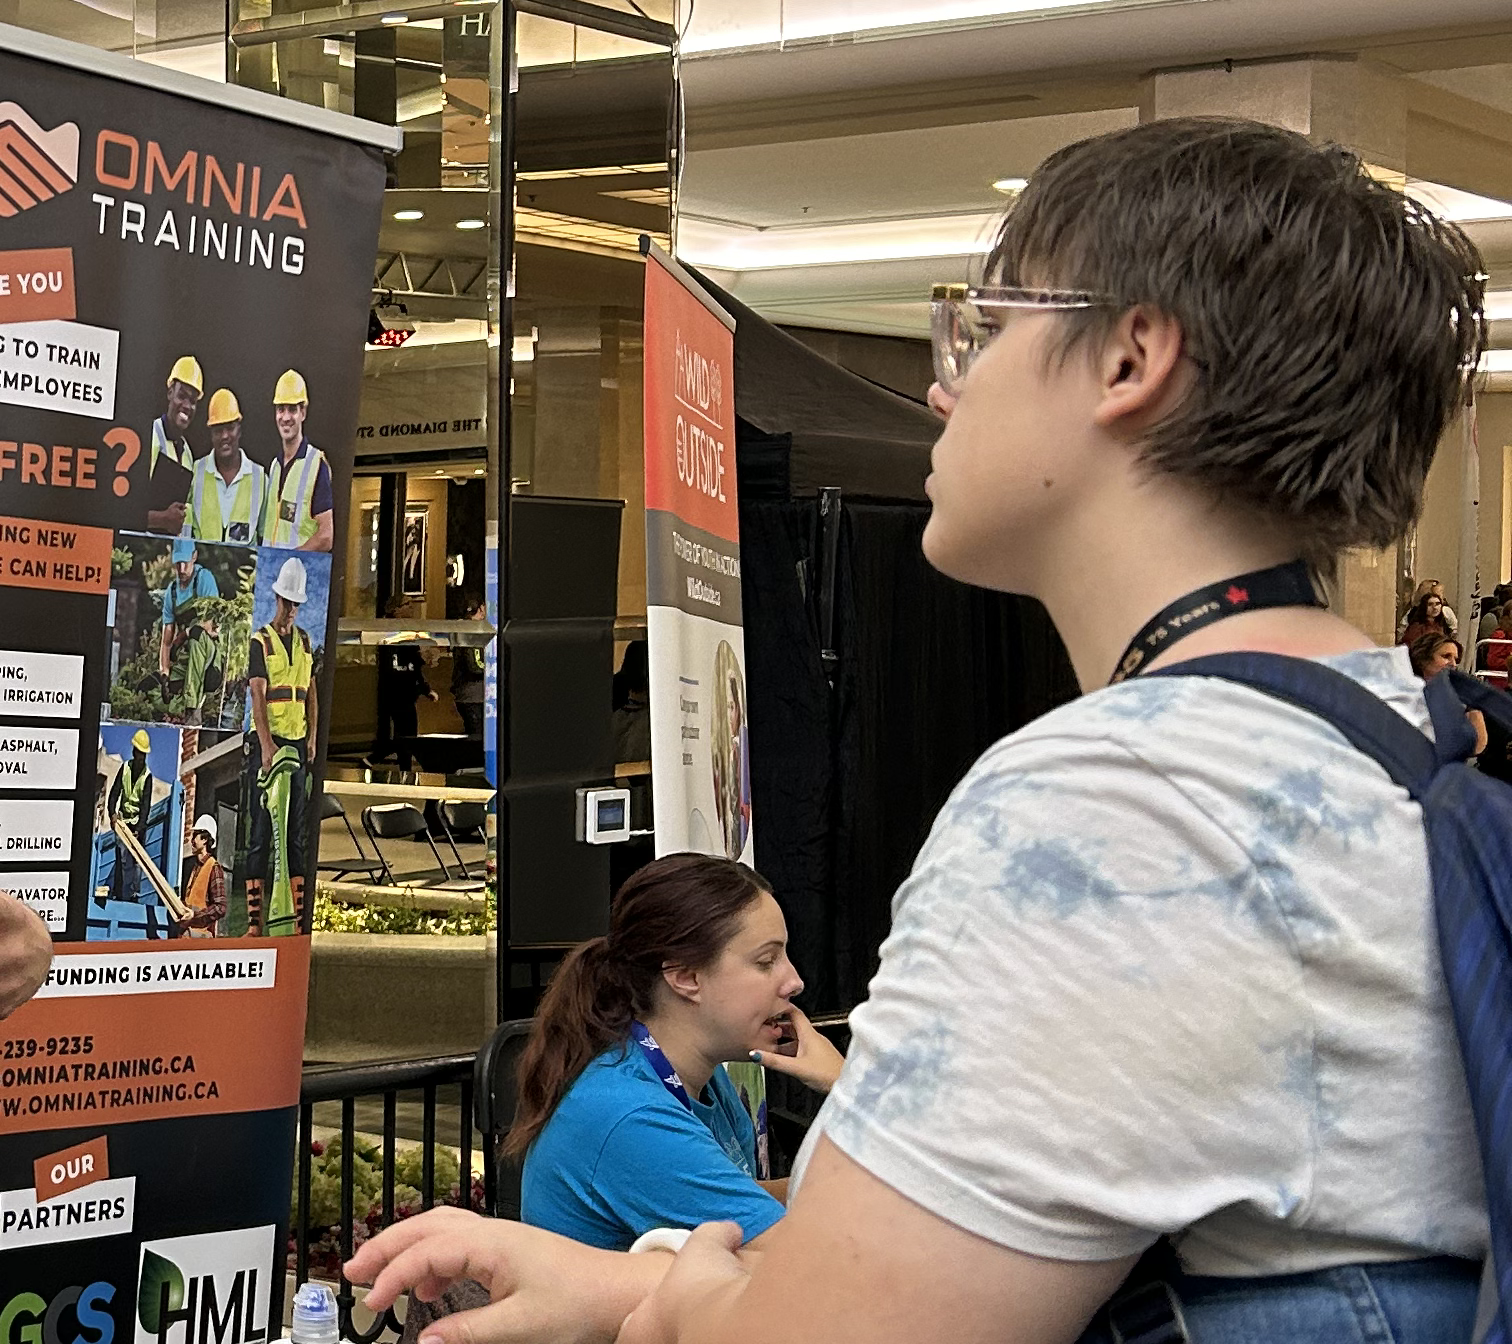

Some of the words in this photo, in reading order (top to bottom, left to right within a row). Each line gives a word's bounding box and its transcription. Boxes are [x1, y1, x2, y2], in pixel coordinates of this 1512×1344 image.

[96, 129, 307, 228] OMNIA
[91, 194, 305, 276] TRAINING
[14, 272, 62, 295] YOU
[12, 337, 39, 359] TO
[45, 343, 101, 370] TRAIN
[675, 414, 726, 504] OUTSIDE
[37, 528, 77, 549] NEW
[6, 556, 48, 579] CAN
[52, 560, 103, 584] HELP!
[3, 687, 74, 706] IRRIGATION
[0, 737, 58, 756] ASPHALT,
[6, 835, 62, 851] DRILLING
[2, 887, 69, 902] CAVATOR,
[45, 966, 130, 988] FUNDING
[136, 966, 152, 983] IS
[158, 962, 264, 982] AVAILABLE!
[50, 1155, 95, 1184] OUR
[2, 1198, 126, 1234] PARTNERS
